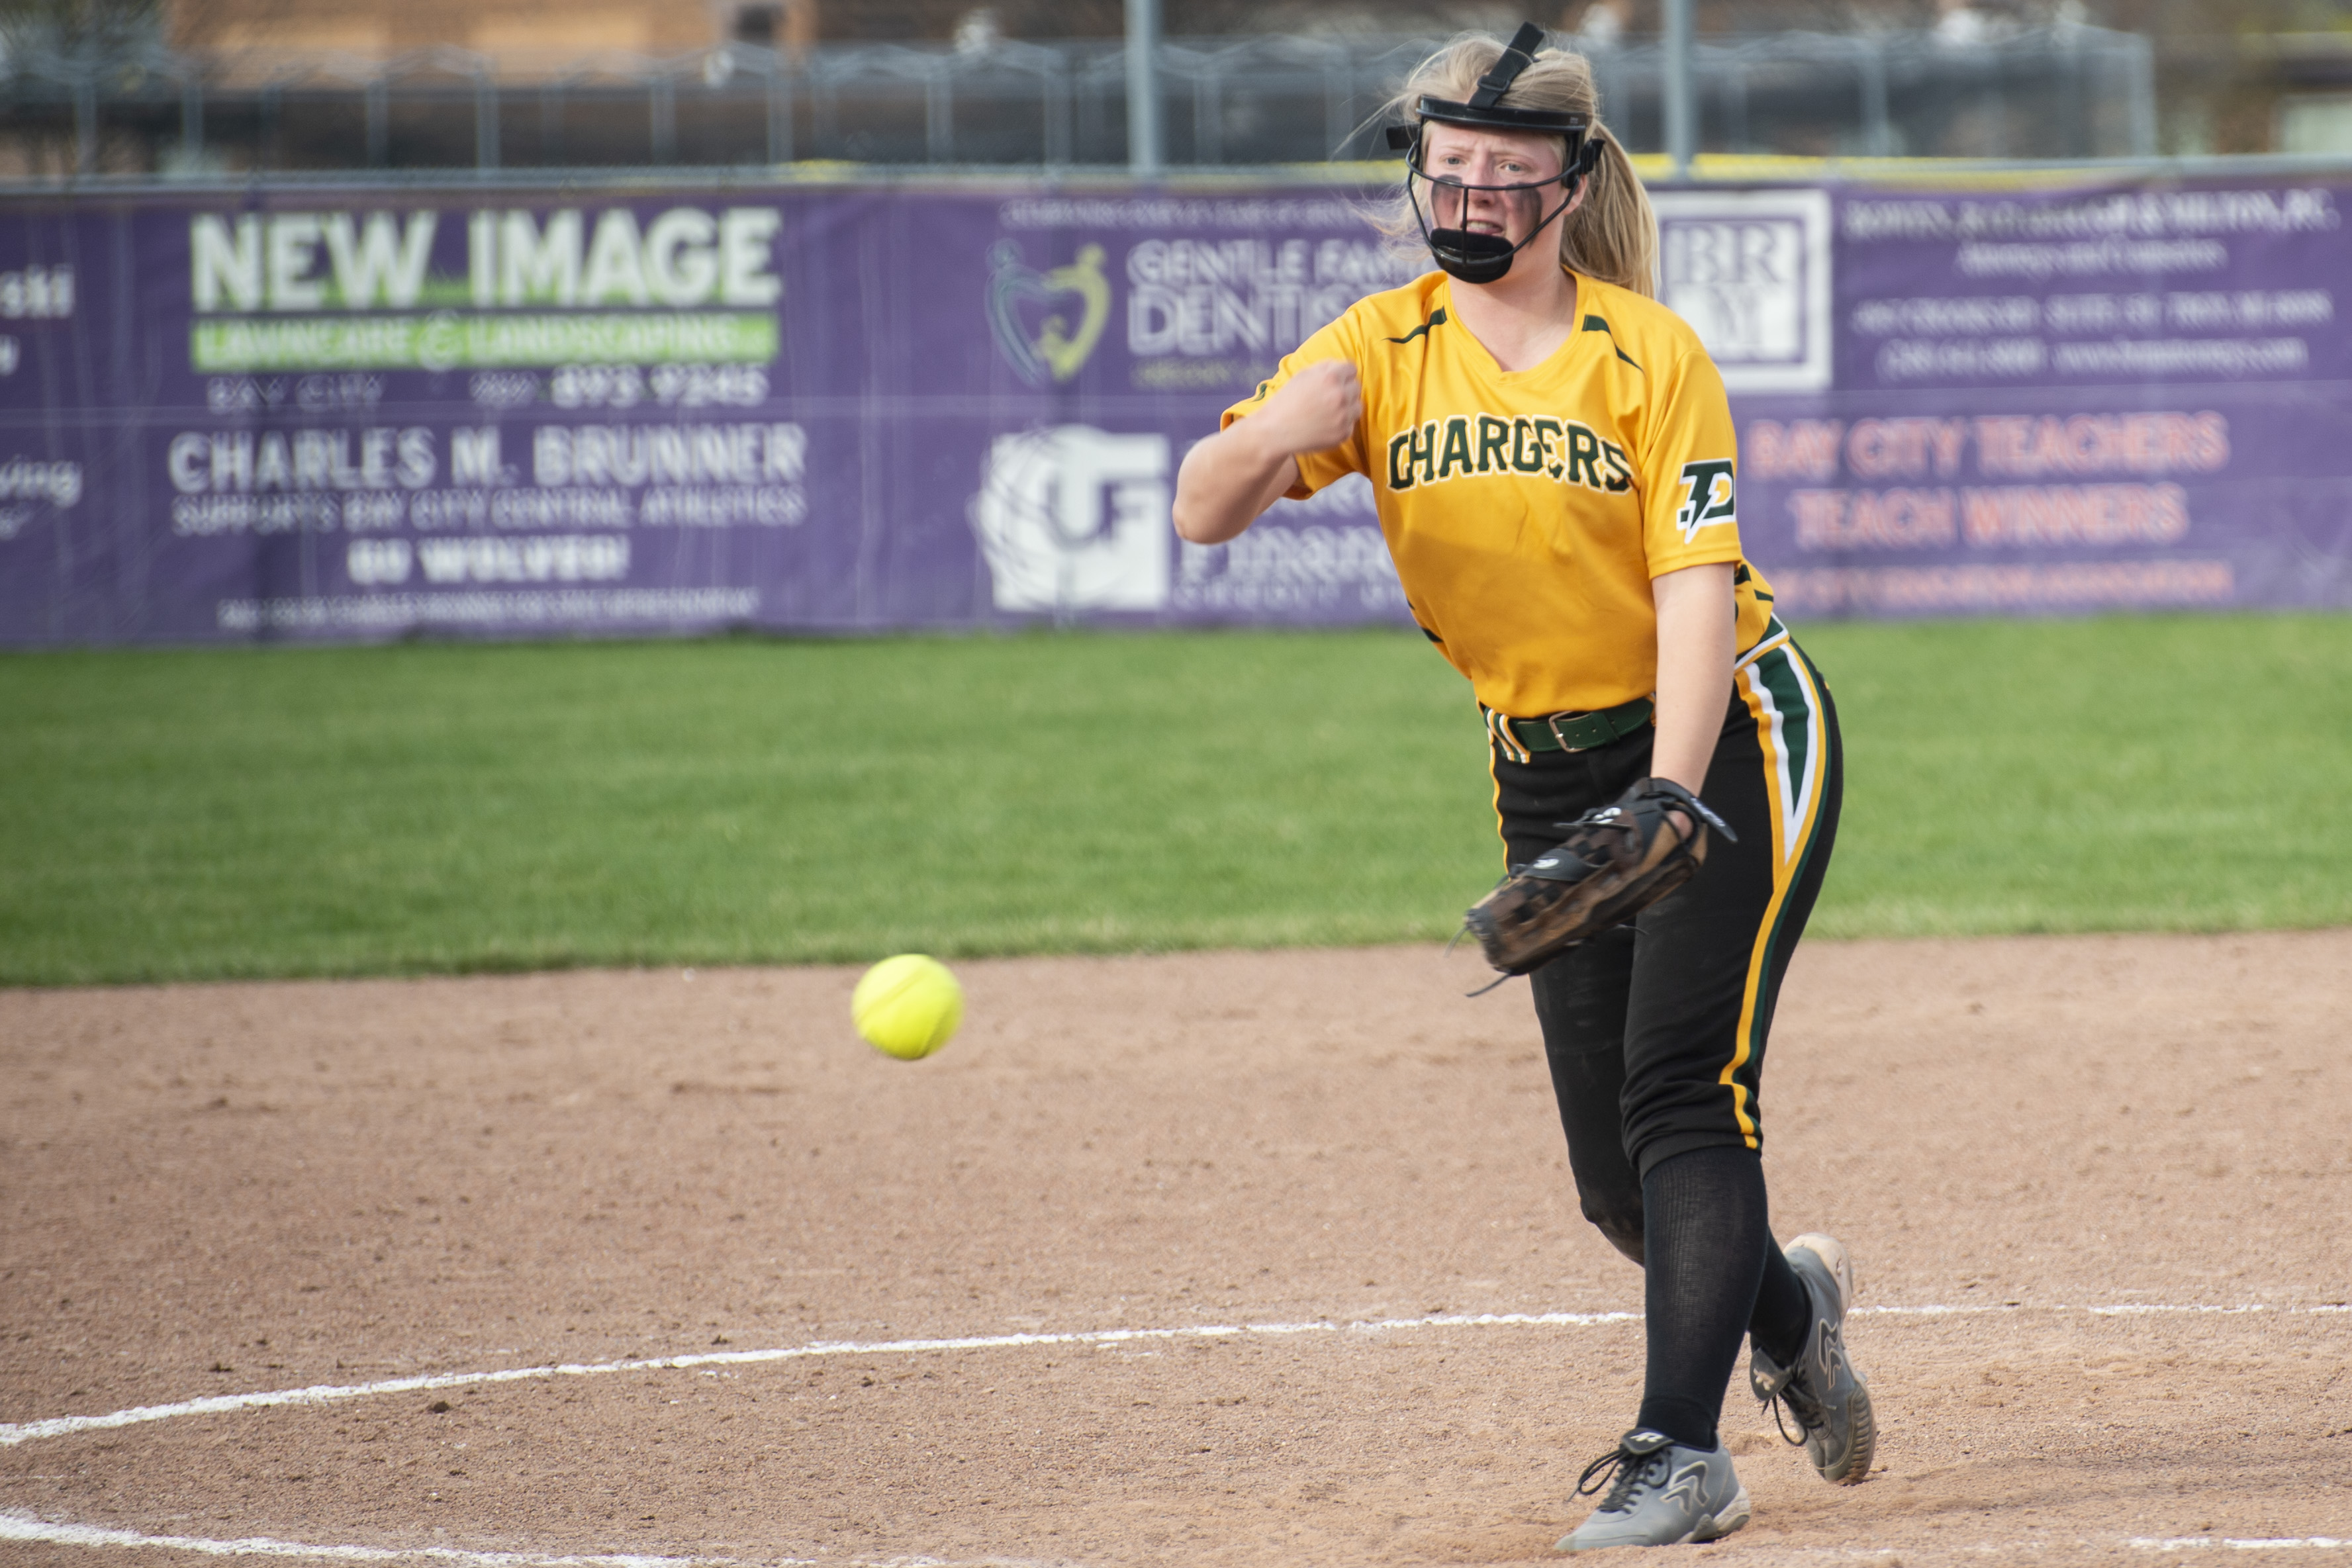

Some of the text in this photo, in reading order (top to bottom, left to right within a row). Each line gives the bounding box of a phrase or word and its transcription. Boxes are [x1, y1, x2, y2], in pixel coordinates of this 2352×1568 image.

[192, 207, 782, 312] NEW IMAGE
[168, 422, 808, 494] CHARLES M. BRUNNER
[1388, 412, 1634, 495] CHARGERS
[1850, 418, 1966, 478] CITY
[1973, 412, 2229, 475] TEACHERS
[1791, 483, 2188, 548] TEACH WINNERS
